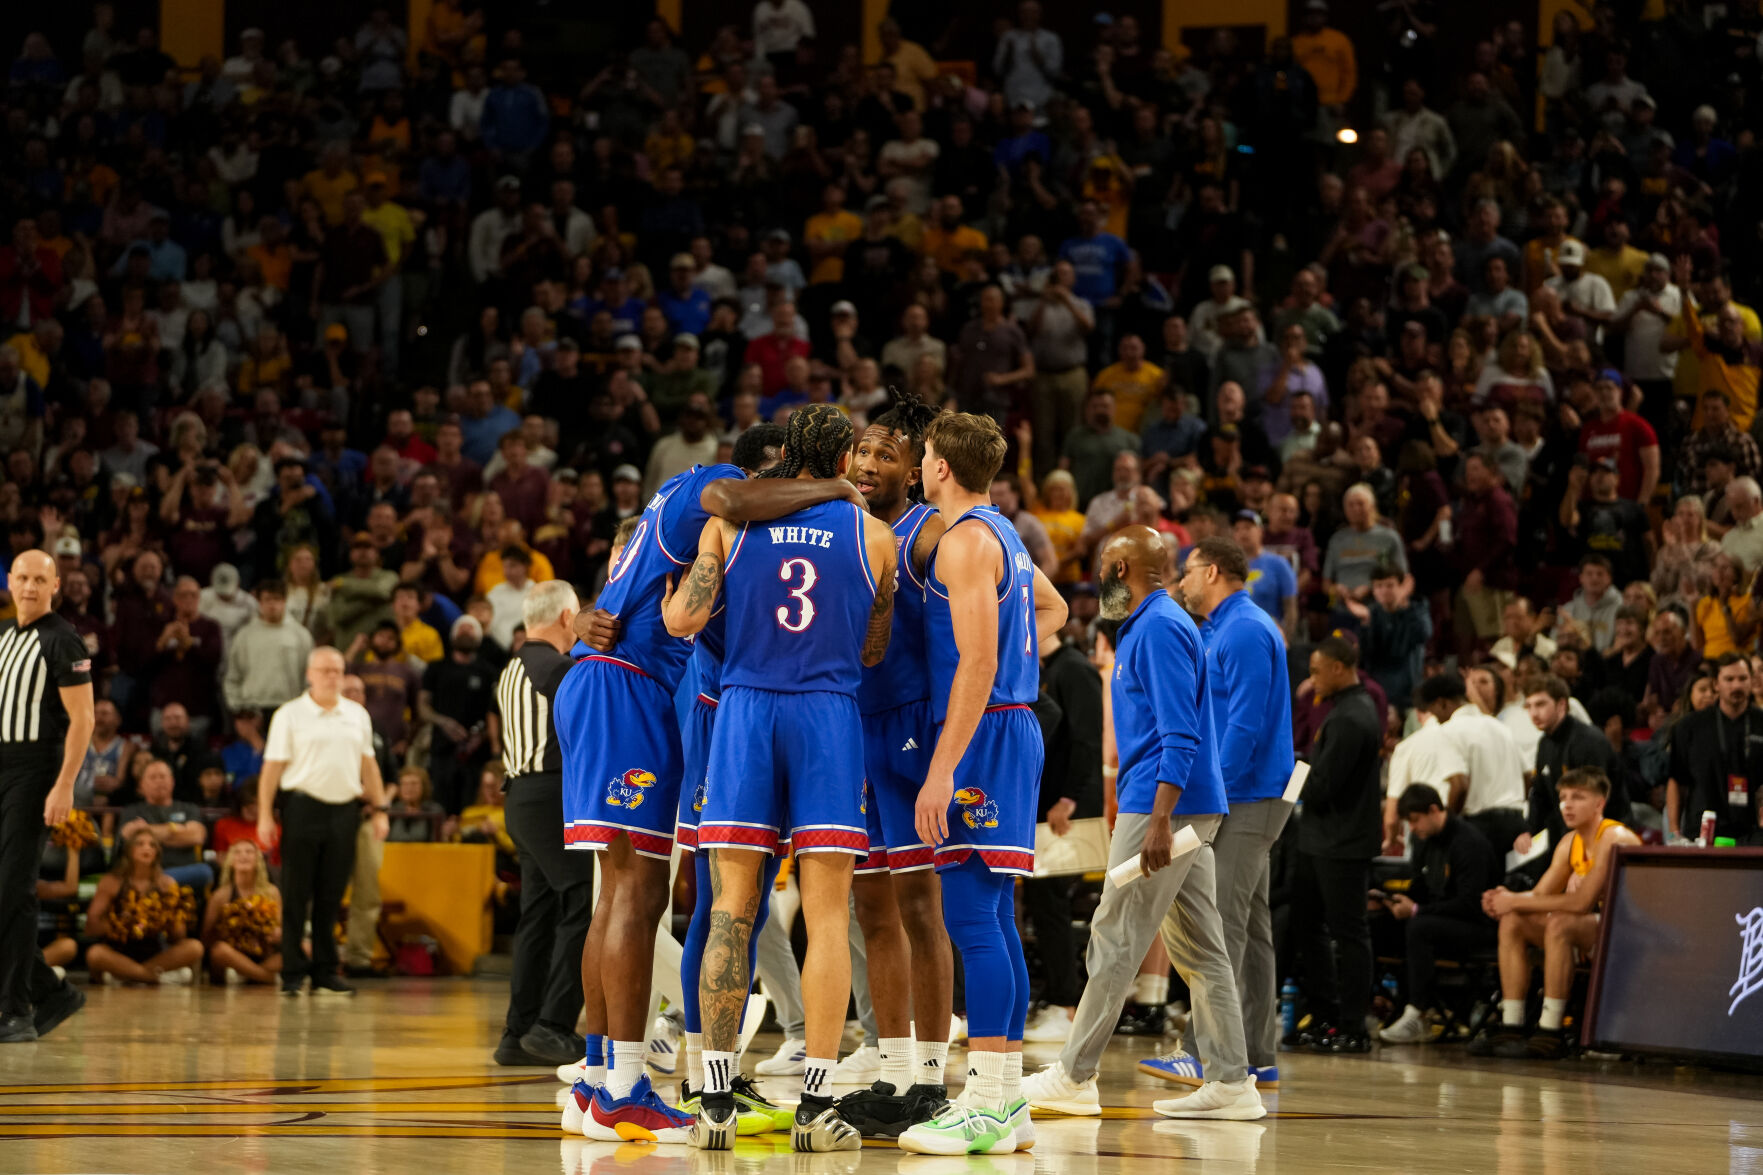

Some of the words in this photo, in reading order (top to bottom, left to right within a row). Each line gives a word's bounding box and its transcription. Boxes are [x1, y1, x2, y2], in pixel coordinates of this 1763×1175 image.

[768, 526, 834, 549] WHITE
[776, 557, 820, 633] 3
[620, 787, 632, 797] KU
[976, 808, 988, 817] KU
